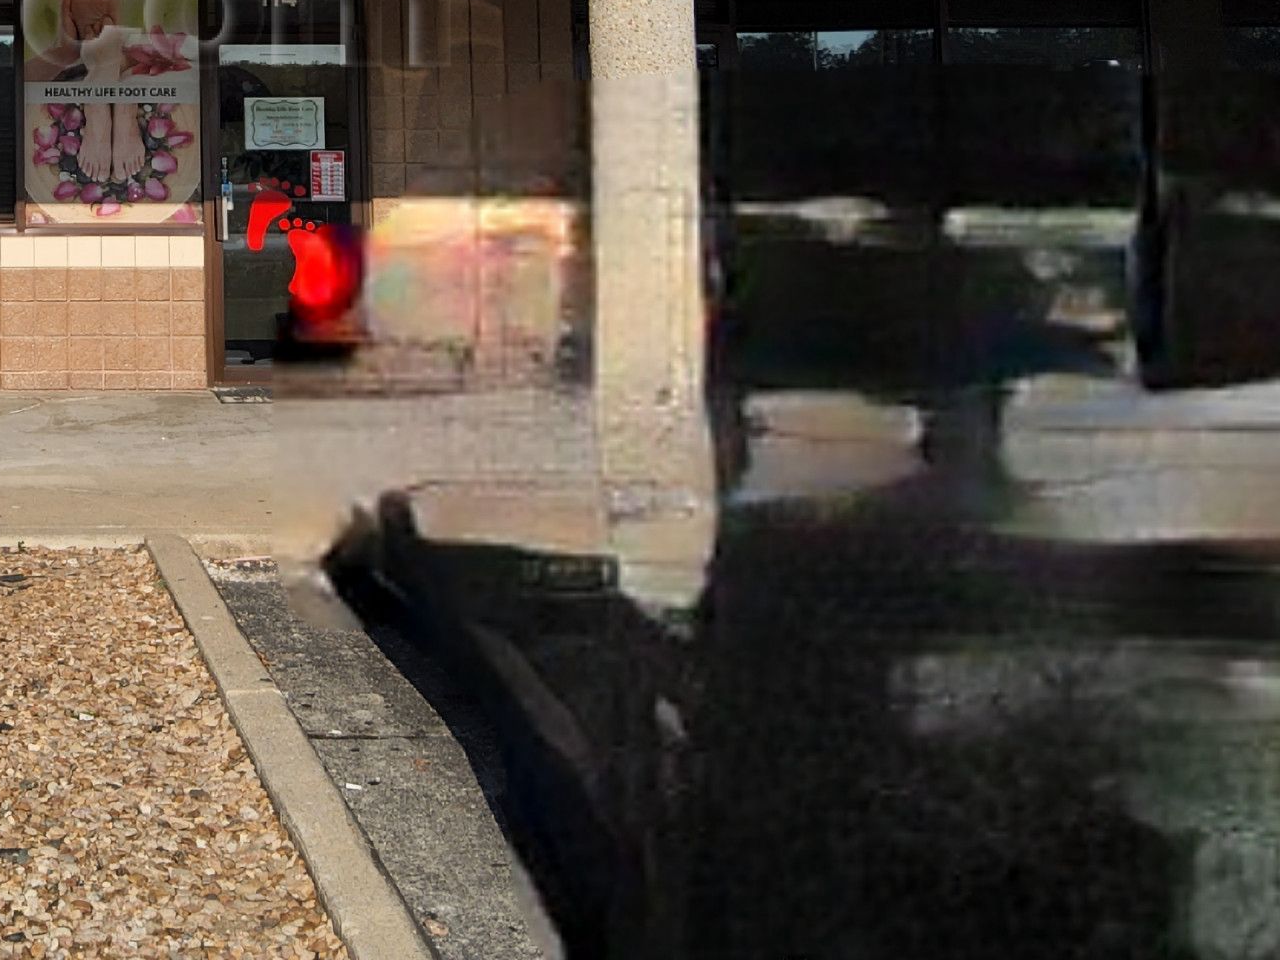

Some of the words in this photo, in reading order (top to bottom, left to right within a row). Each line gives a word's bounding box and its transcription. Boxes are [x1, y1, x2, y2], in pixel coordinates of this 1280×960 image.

[45, 87, 92, 97] HEALTHY
[95, 87, 116, 97] LIFE
[119, 87, 147, 97] FOOT
[149, 87, 177, 97] CARE
